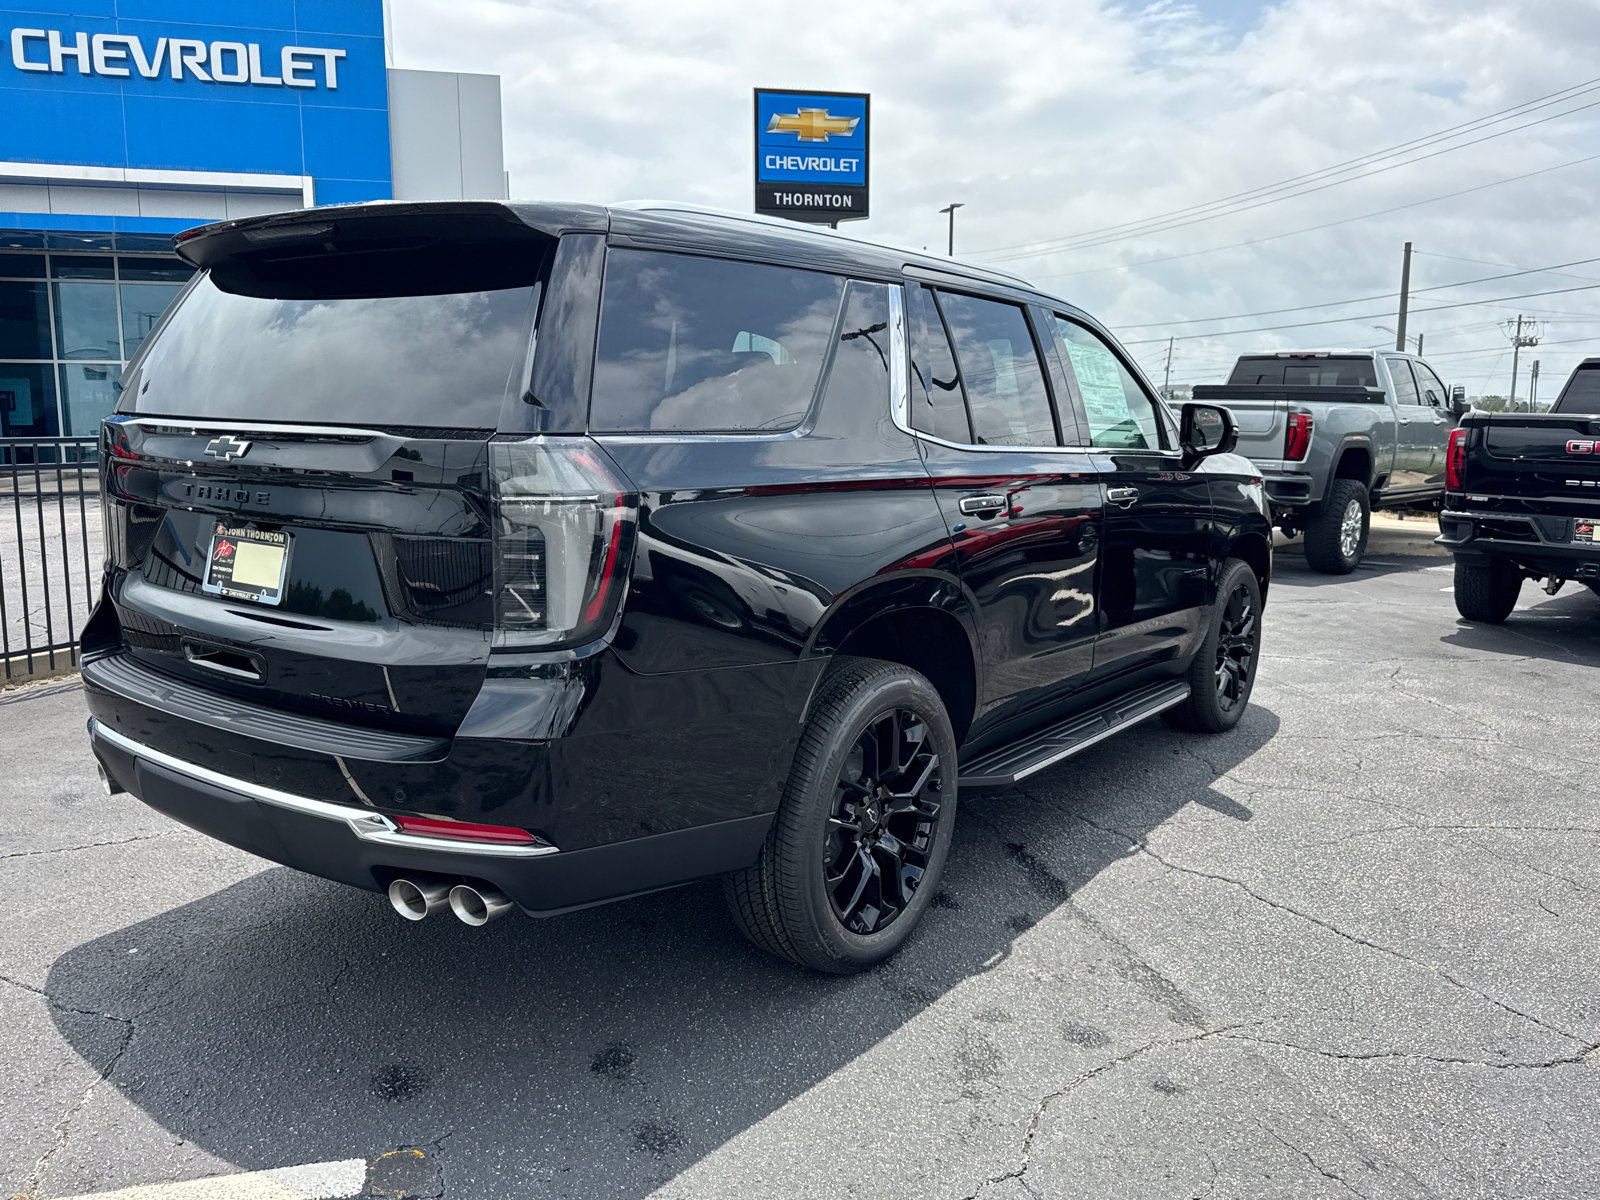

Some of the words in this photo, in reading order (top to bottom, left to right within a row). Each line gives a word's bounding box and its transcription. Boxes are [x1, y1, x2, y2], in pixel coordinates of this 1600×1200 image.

[10, 27, 347, 89] CHEVROLET
[765, 155, 860, 172] CHEVROLET
[773, 192, 852, 208] THORNTON
[182, 483, 271, 506] TAHOE
[228, 527, 246, 538] JOHN
[246, 529, 285, 543] THORNTON
[228, 590, 252, 600] CHEVROLET
[310, 693, 390, 715] PREMIER
[809, 749, 842, 844] BRIDGESTONE
